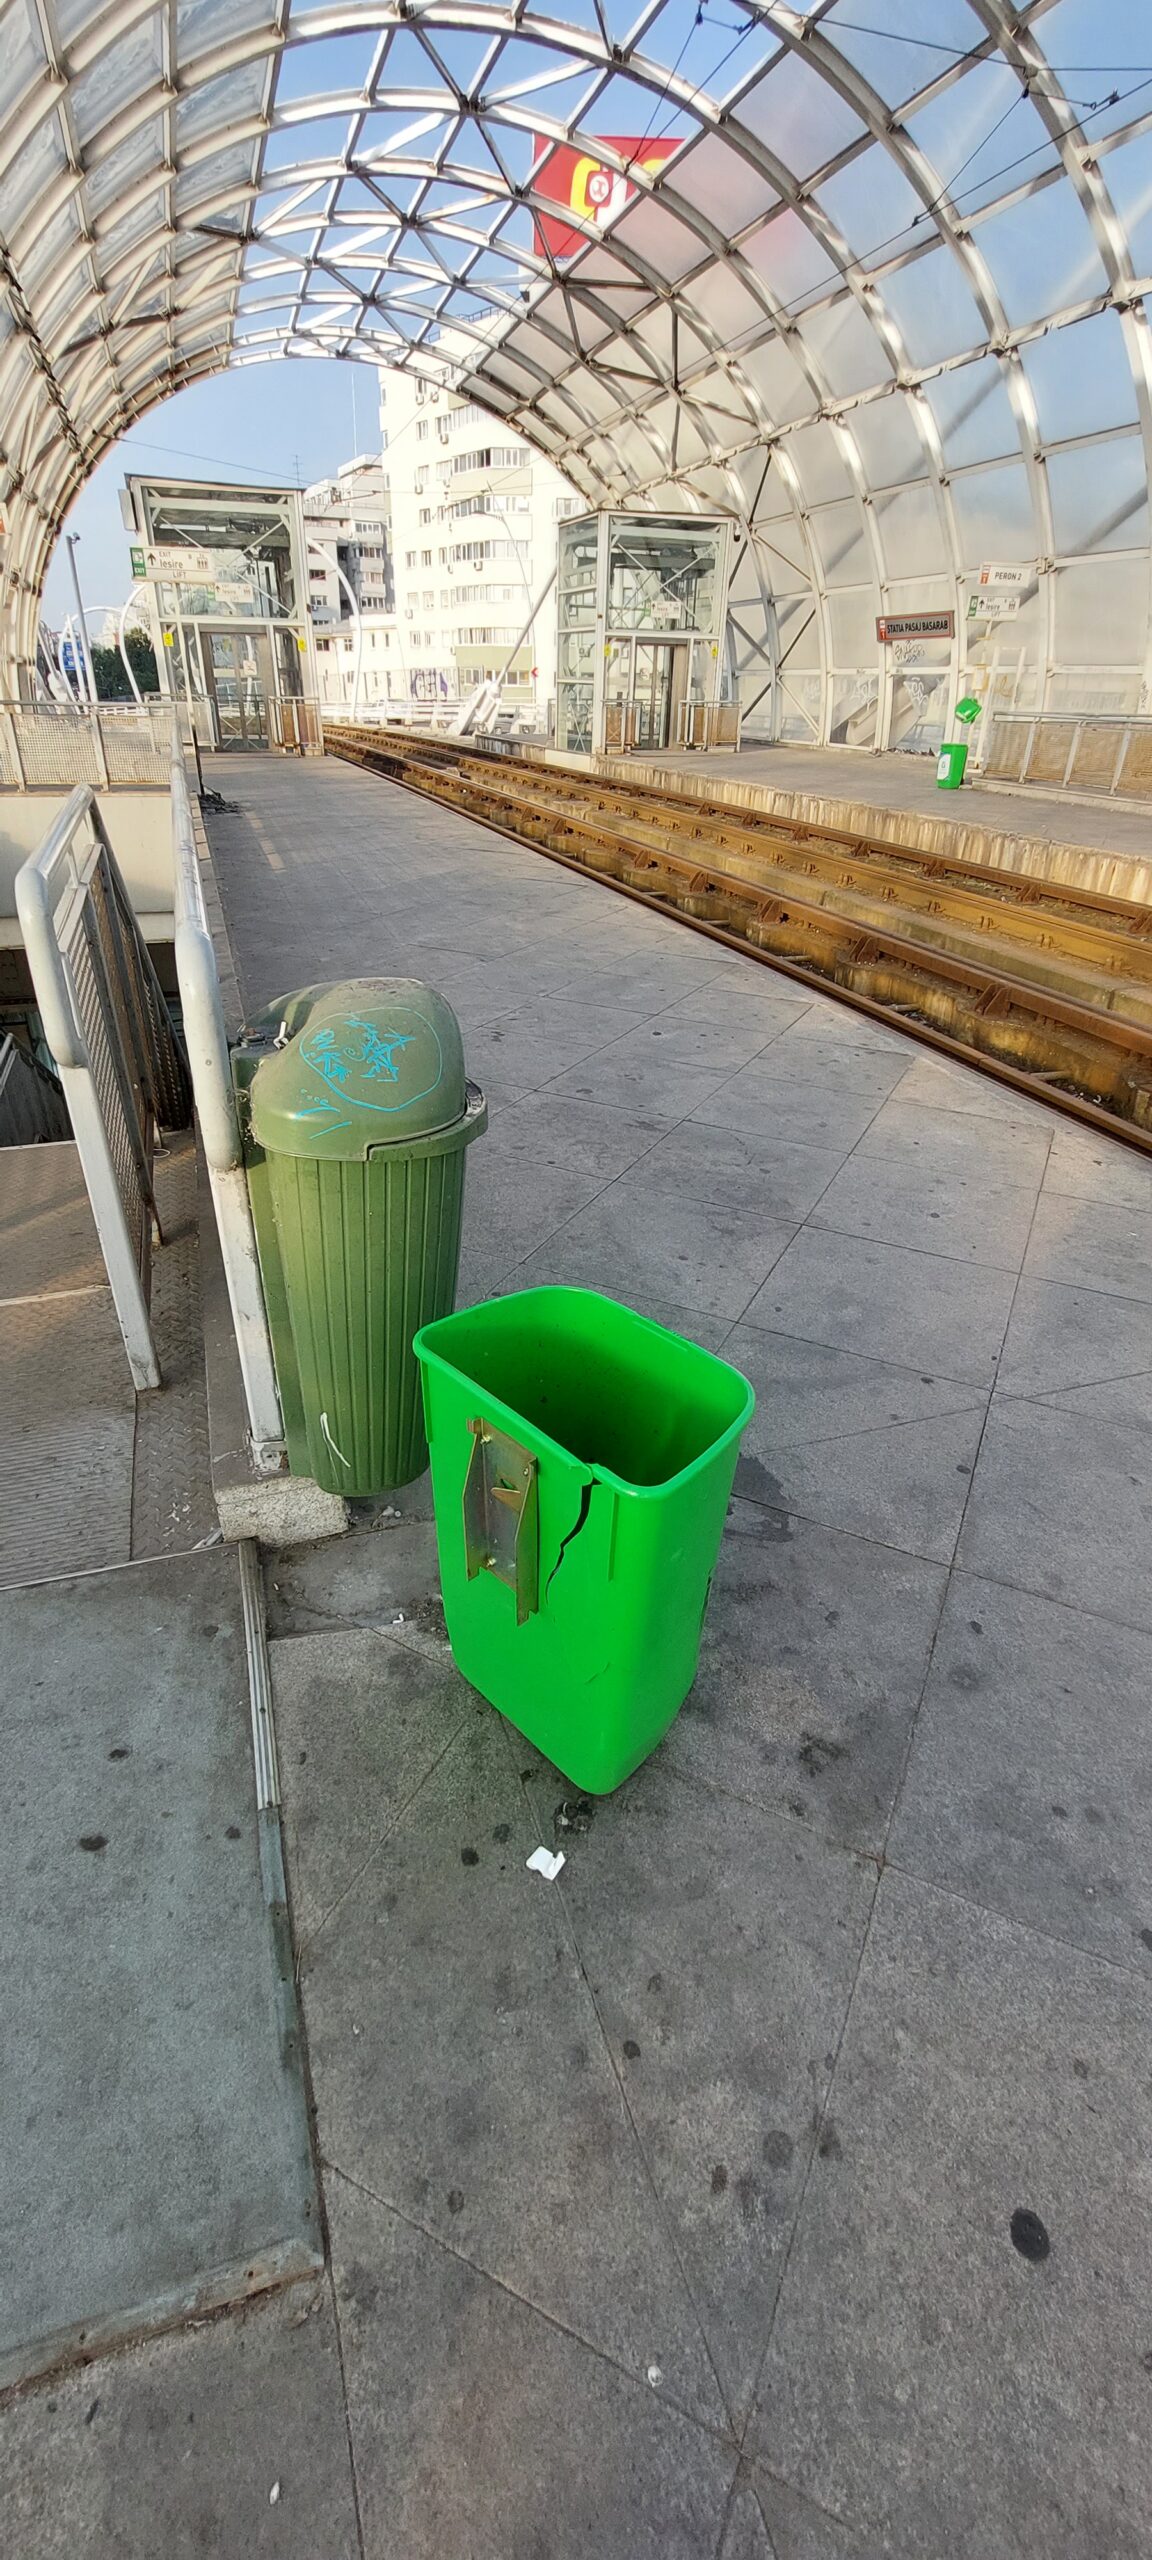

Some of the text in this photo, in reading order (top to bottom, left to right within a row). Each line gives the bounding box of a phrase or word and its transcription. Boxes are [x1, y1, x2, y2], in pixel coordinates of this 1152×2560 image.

[173, 571, 186, 579] LIFT
[994, 572, 1022, 581] PERON 2
[905, 622, 921, 632] PASAJ
[922, 619, 949, 631] BASARAB
